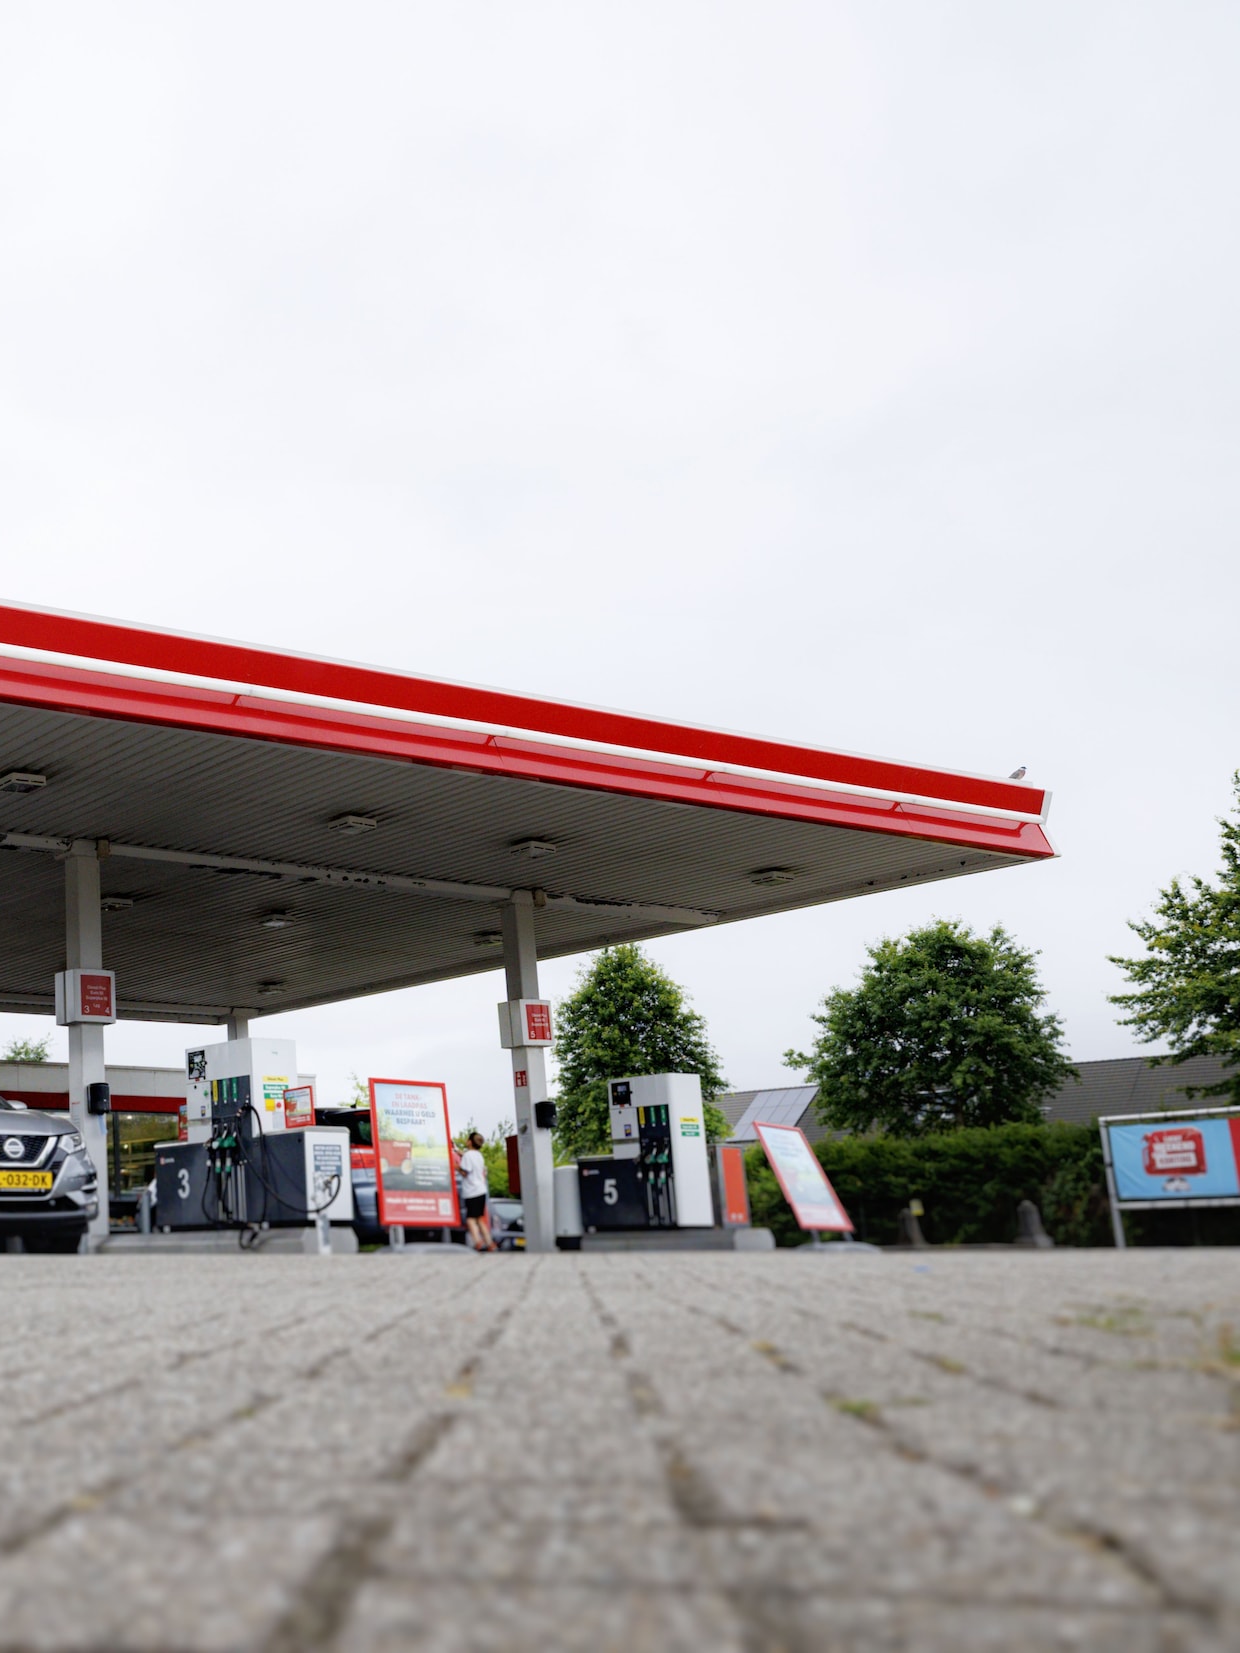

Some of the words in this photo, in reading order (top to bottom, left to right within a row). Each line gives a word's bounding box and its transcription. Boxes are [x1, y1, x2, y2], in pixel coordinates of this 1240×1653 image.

[84, 1005, 90, 1014] 3
[105, 1007, 111, 1015] 4
[530, 1030, 536, 1039] 5
[177, 1168, 191, 1199] 3
[603, 1178, 619, 1205] 5
